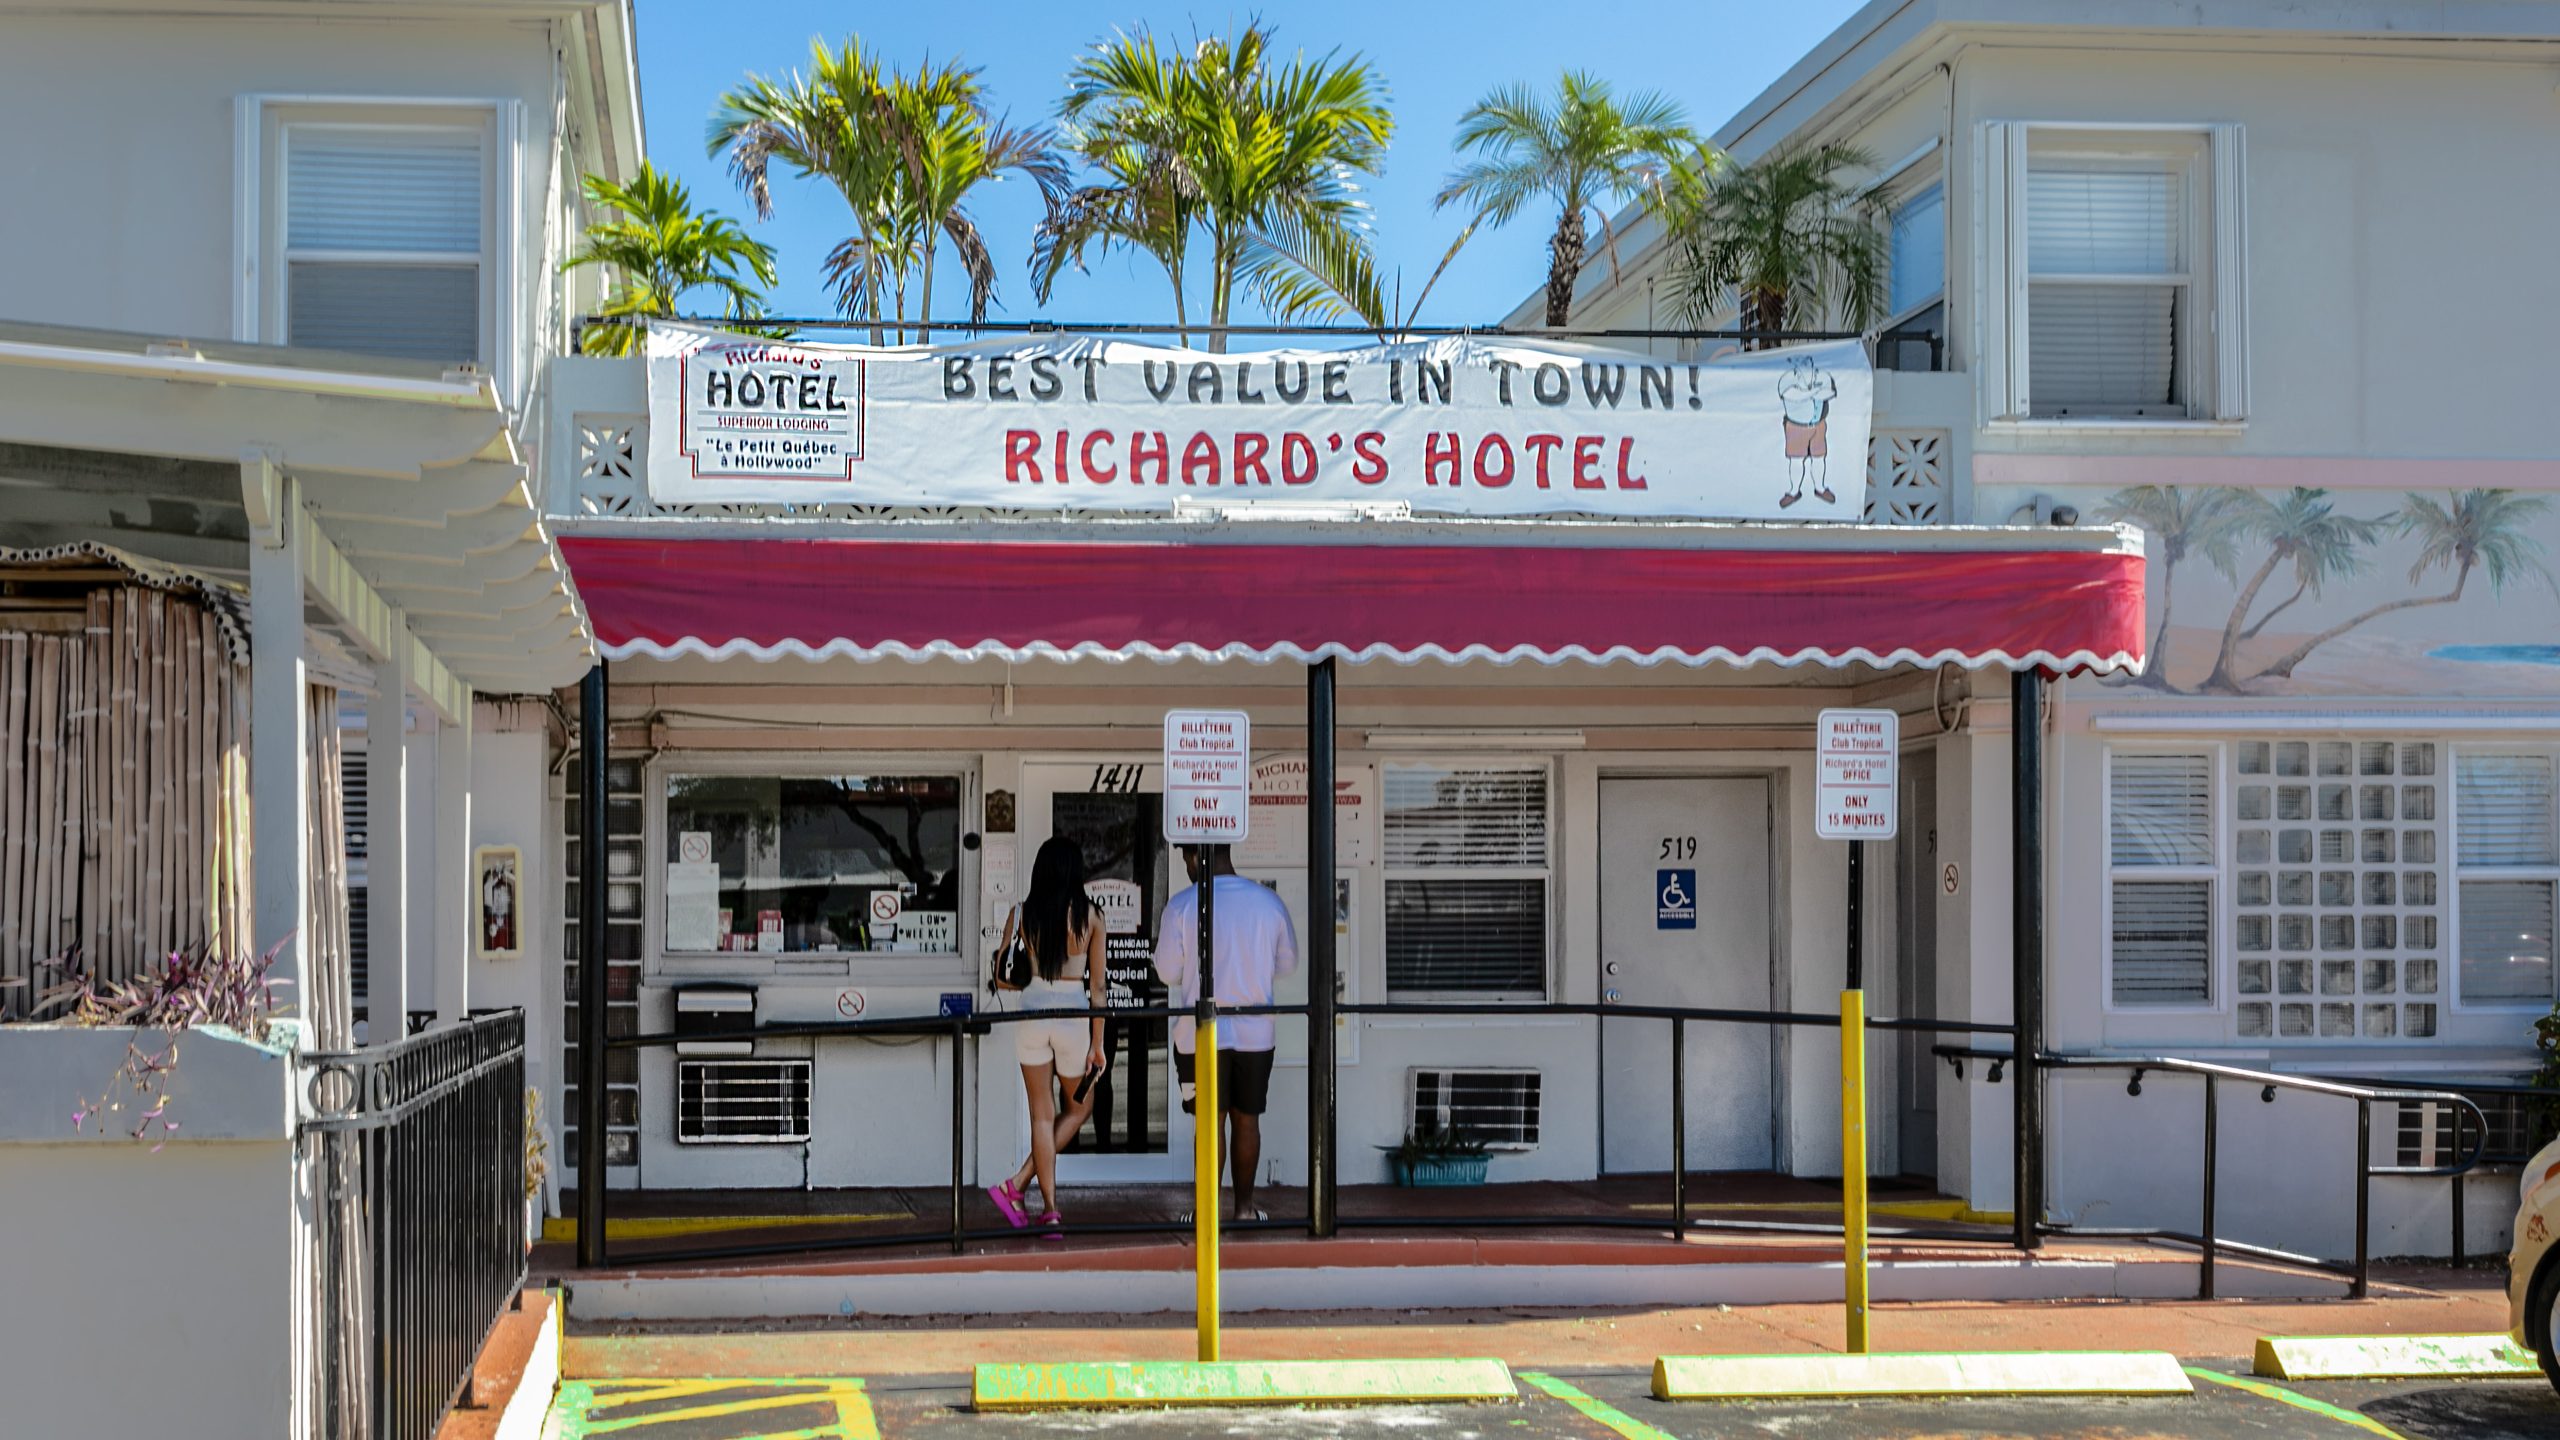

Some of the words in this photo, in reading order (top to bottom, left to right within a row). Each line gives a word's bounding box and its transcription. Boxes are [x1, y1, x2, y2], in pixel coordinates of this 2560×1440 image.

[725, 349, 822, 370] Richards
[943, 356, 1107, 403] BEST
[1143, 359, 1353, 406] VALUE
[1390, 358, 1451, 405] IN
[1488, 360, 1703, 410] TOWN!
[707, 370, 847, 411] HOTEL
[717, 415, 773, 428] SUPERIOR
[776, 417, 829, 431] LODGING
[706, 438, 733, 452] "Le
[740, 439, 775, 454] Petit
[782, 439, 837, 455] Québec
[721, 454, 728, 468] à
[736, 454, 821, 470] Hollywood"
[1005, 429, 1389, 486] RICHARD'S
[1425, 431, 1648, 490] HOTEL
[1181, 722, 1232, 735] BILLETTERIE
[1833, 722, 1882, 734] BILLETTERIE
[1179, 739, 1198, 749] Club
[1201, 738, 1234, 752] Tropical
[1831, 738, 1849, 749] Club
[1852, 738, 1883, 751] Tropical
[1173, 760, 1212, 770] Richard's
[1215, 760, 1238, 770] Hotel
[1825, 758, 1863, 769] Richard's
[1865, 759, 1887, 769] Hotel
[1089, 763, 1144, 796] 1411
[1191, 771, 1221, 782] OFFICE
[1843, 770, 1871, 780] OFFICE
[1264, 780, 1308, 791] HOT
[1194, 797, 1219, 811] ONLY
[1845, 795, 1868, 808] ONLY
[1176, 815, 1188, 828] 15
[1192, 816, 1236, 830] MINUTES
[1828, 813, 1839, 826] 15
[1843, 813, 1885, 826] MINUTES
[1659, 836, 1697, 860] 519
[1091, 894, 1134, 907] OTEL
[920, 914, 939, 926] LOW
